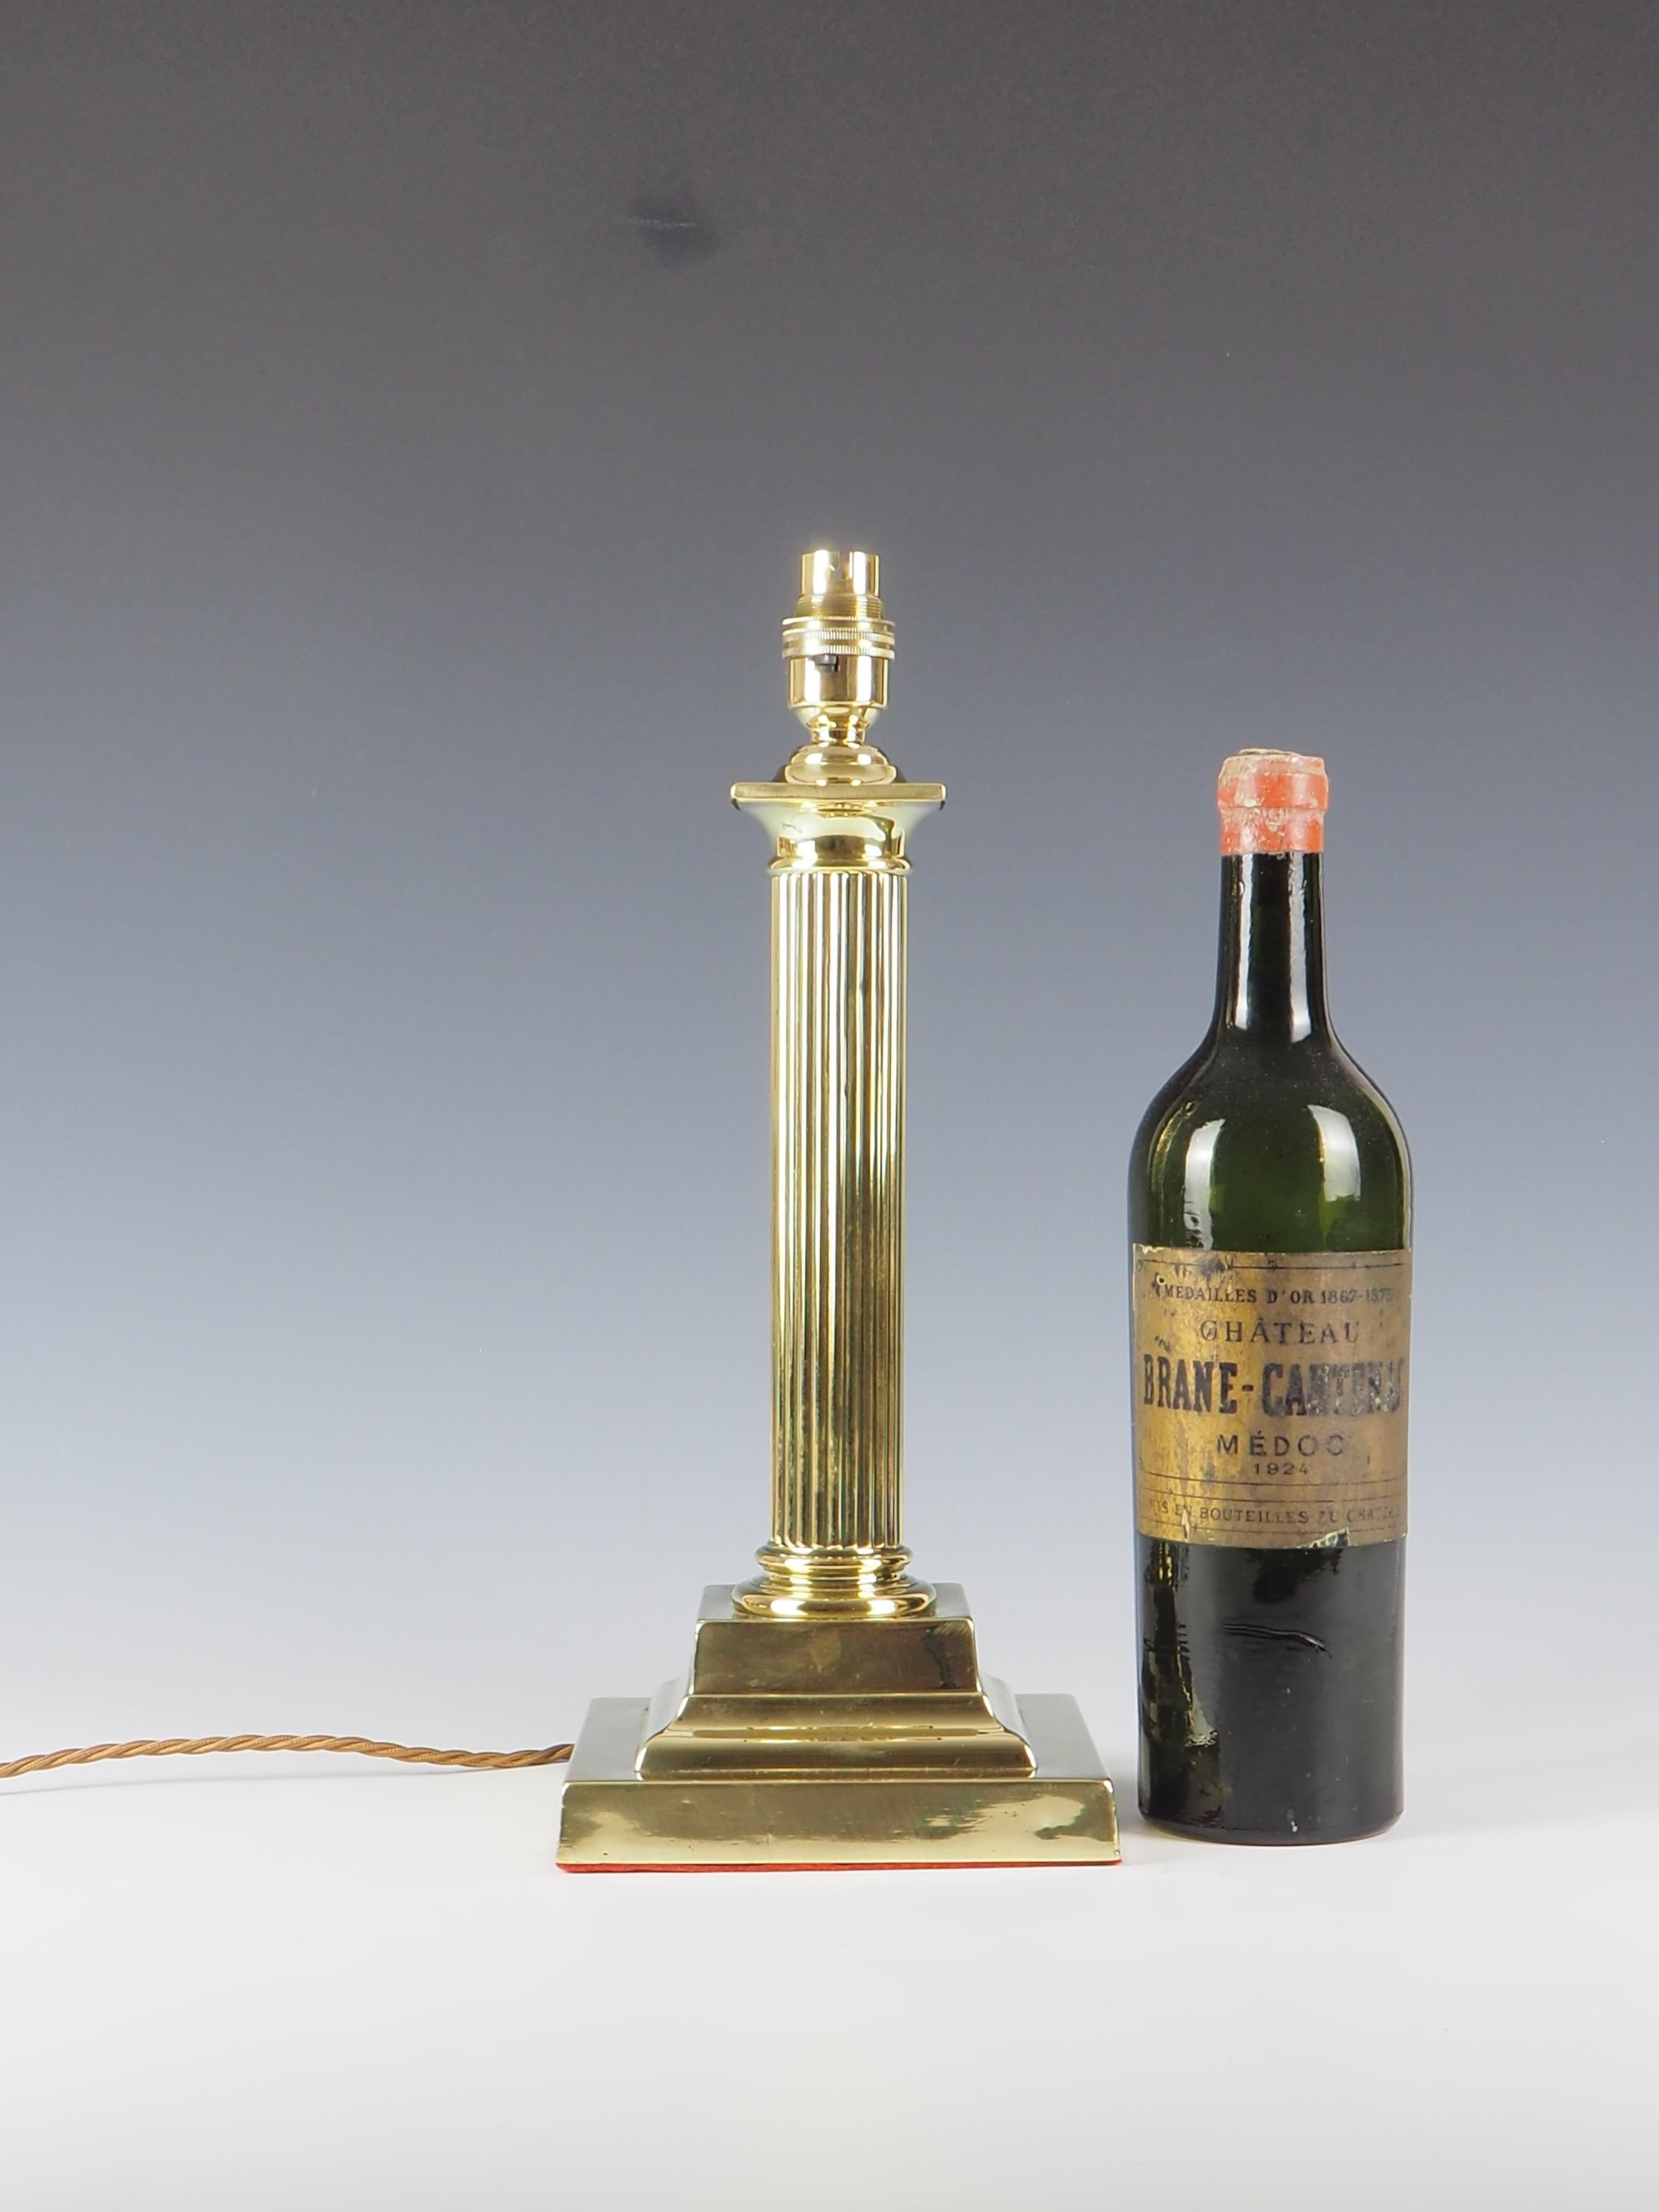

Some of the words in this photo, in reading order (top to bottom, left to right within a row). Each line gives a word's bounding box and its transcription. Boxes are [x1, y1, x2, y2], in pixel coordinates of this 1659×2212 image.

[1266, 1289, 1315, 1304] D'OR
[1200, 1317, 1359, 1344] CHÂTEAU
[1217, 1430, 1345, 1456] MÉDOC
[1254, 1462, 1308, 1475] 1924
[1200, 1506, 1310, 1524] BOUTEILLES
